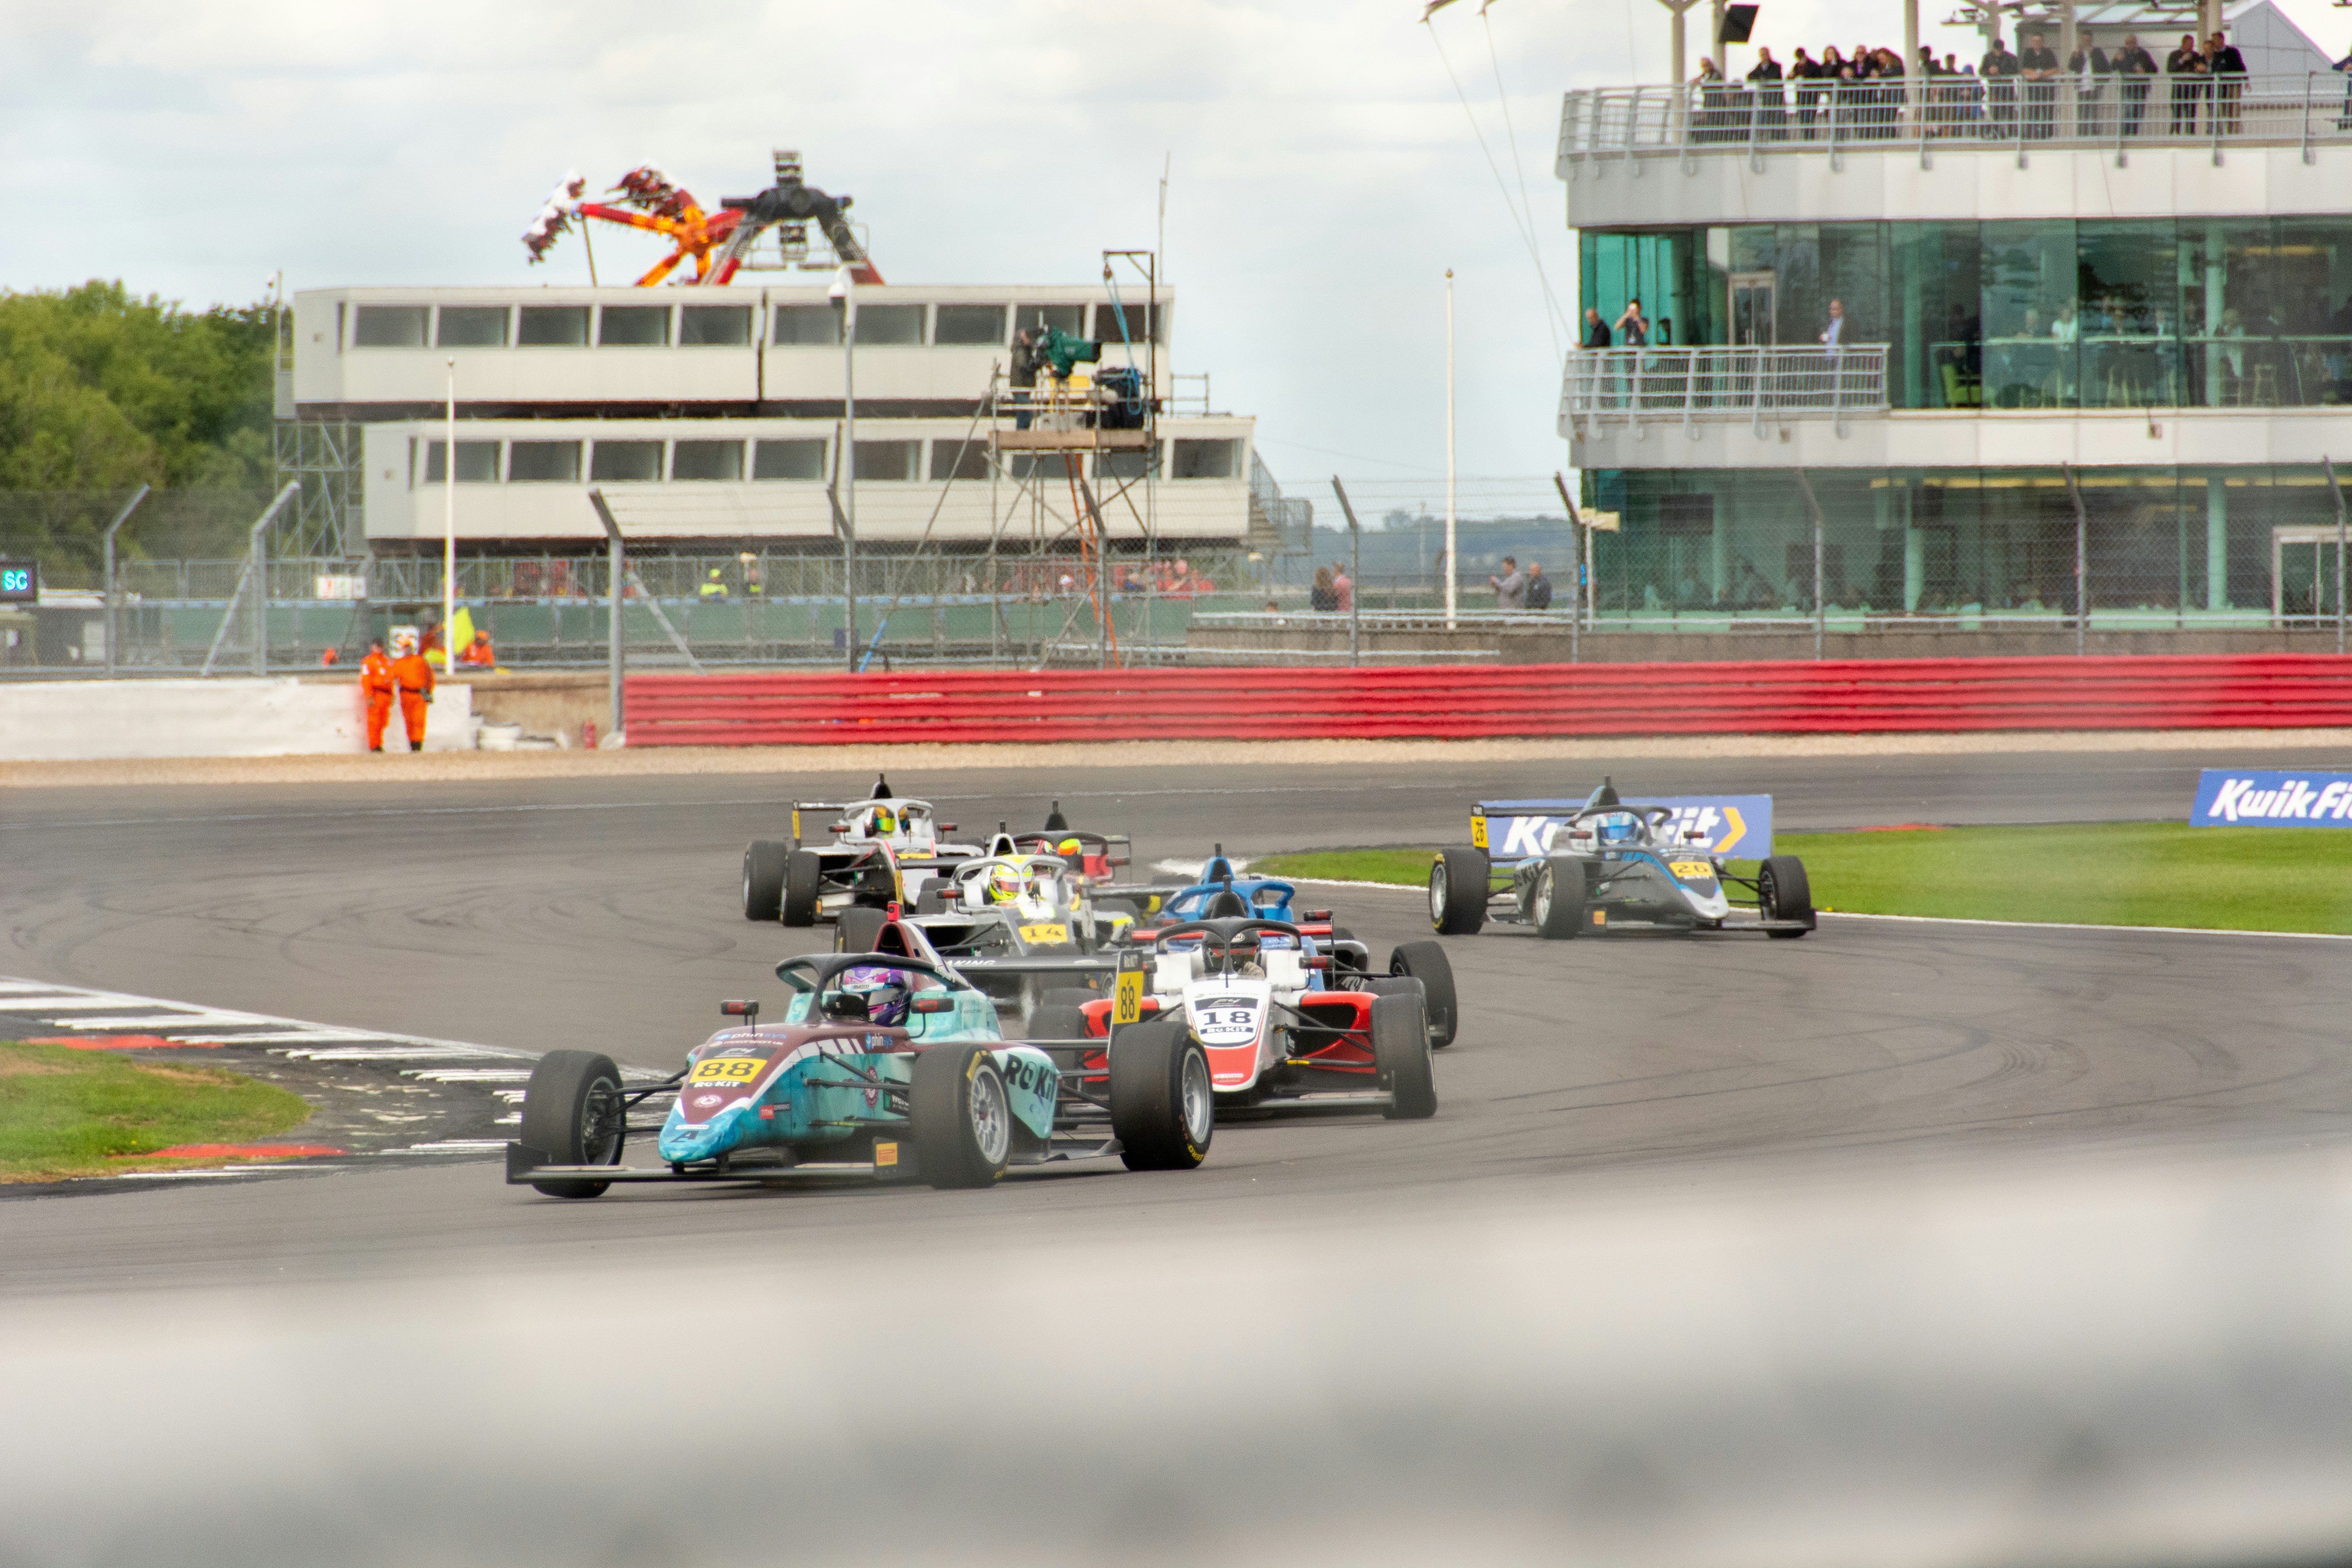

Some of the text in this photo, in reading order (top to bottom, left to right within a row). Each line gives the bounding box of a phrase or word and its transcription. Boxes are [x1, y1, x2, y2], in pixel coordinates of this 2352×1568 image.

[3, 570, 27, 590] SC
[2207, 779, 2352, 821] KwikFi
[1028, 927, 1062, 938] 14
[1121, 985, 1135, 1020] 88
[1203, 1011, 1251, 1025] 18
[698, 1062, 755, 1076] 88
